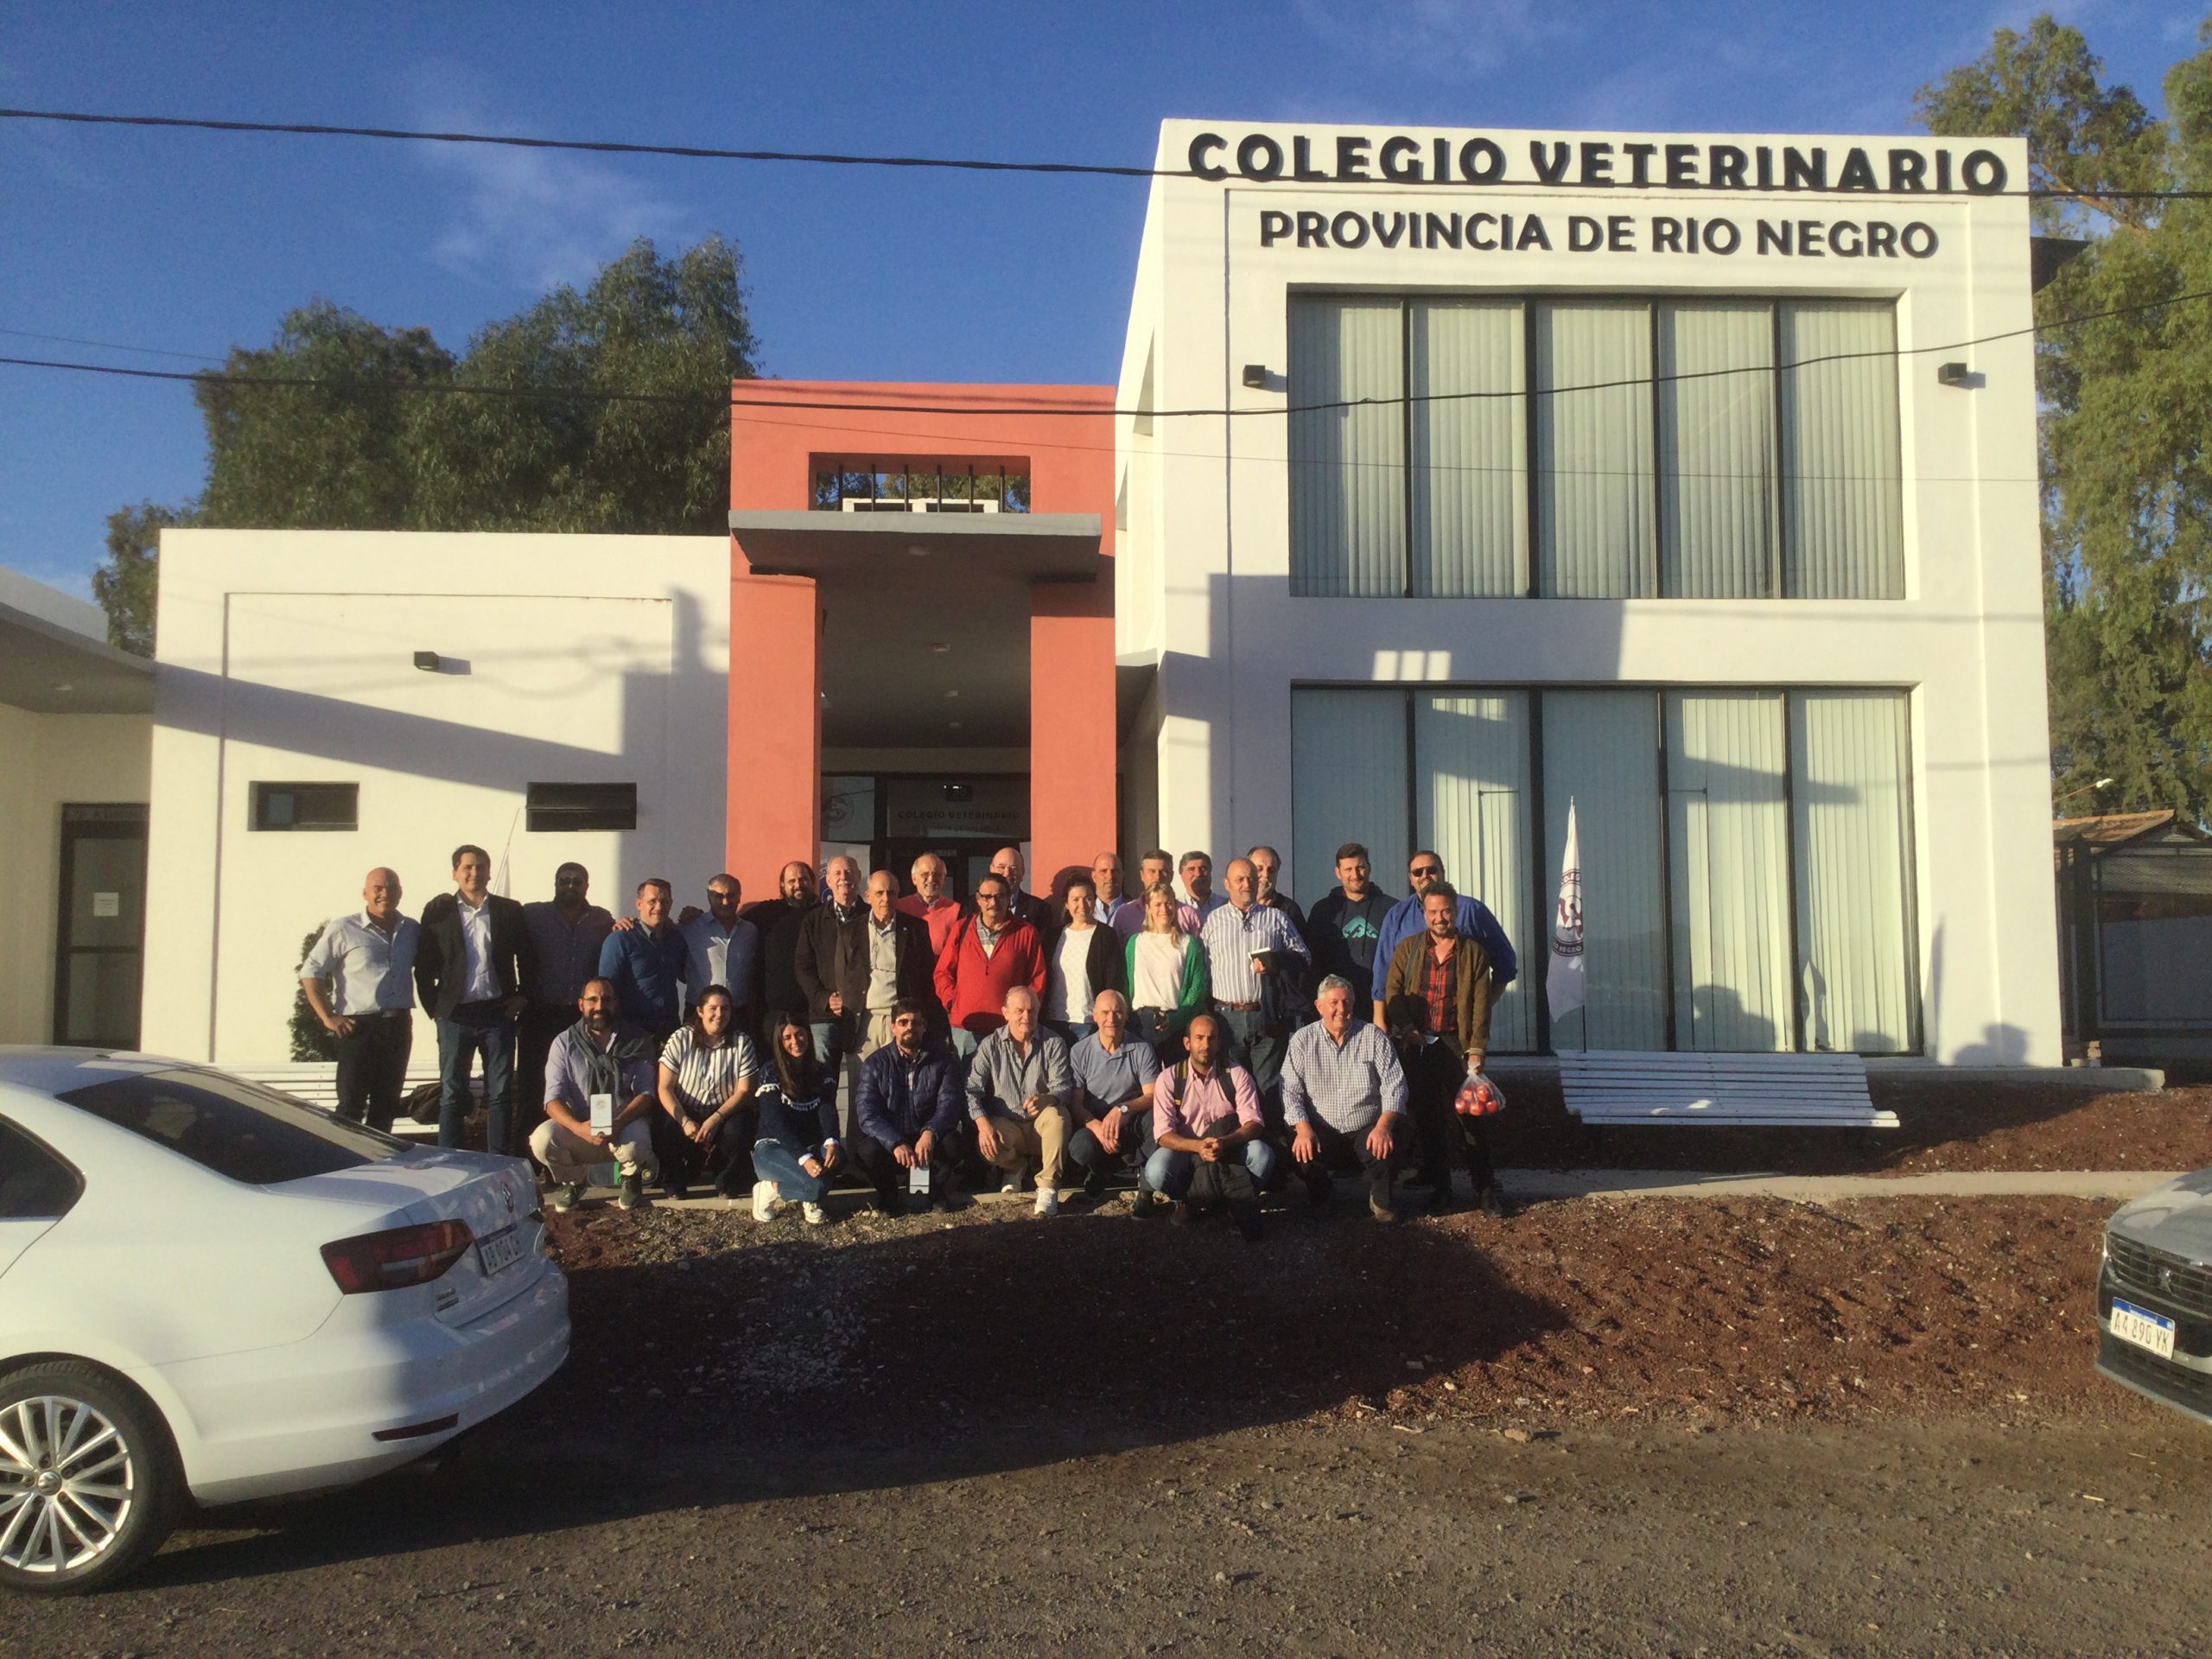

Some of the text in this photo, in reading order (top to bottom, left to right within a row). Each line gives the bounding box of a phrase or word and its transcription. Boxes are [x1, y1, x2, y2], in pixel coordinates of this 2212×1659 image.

[1188, 132, 2008, 196] COLEGIO VETERINARIO
[1260, 210, 1939, 259] PROVINCIA DE RIO NEGRO
[898, 810, 945, 819] COLEGIO
